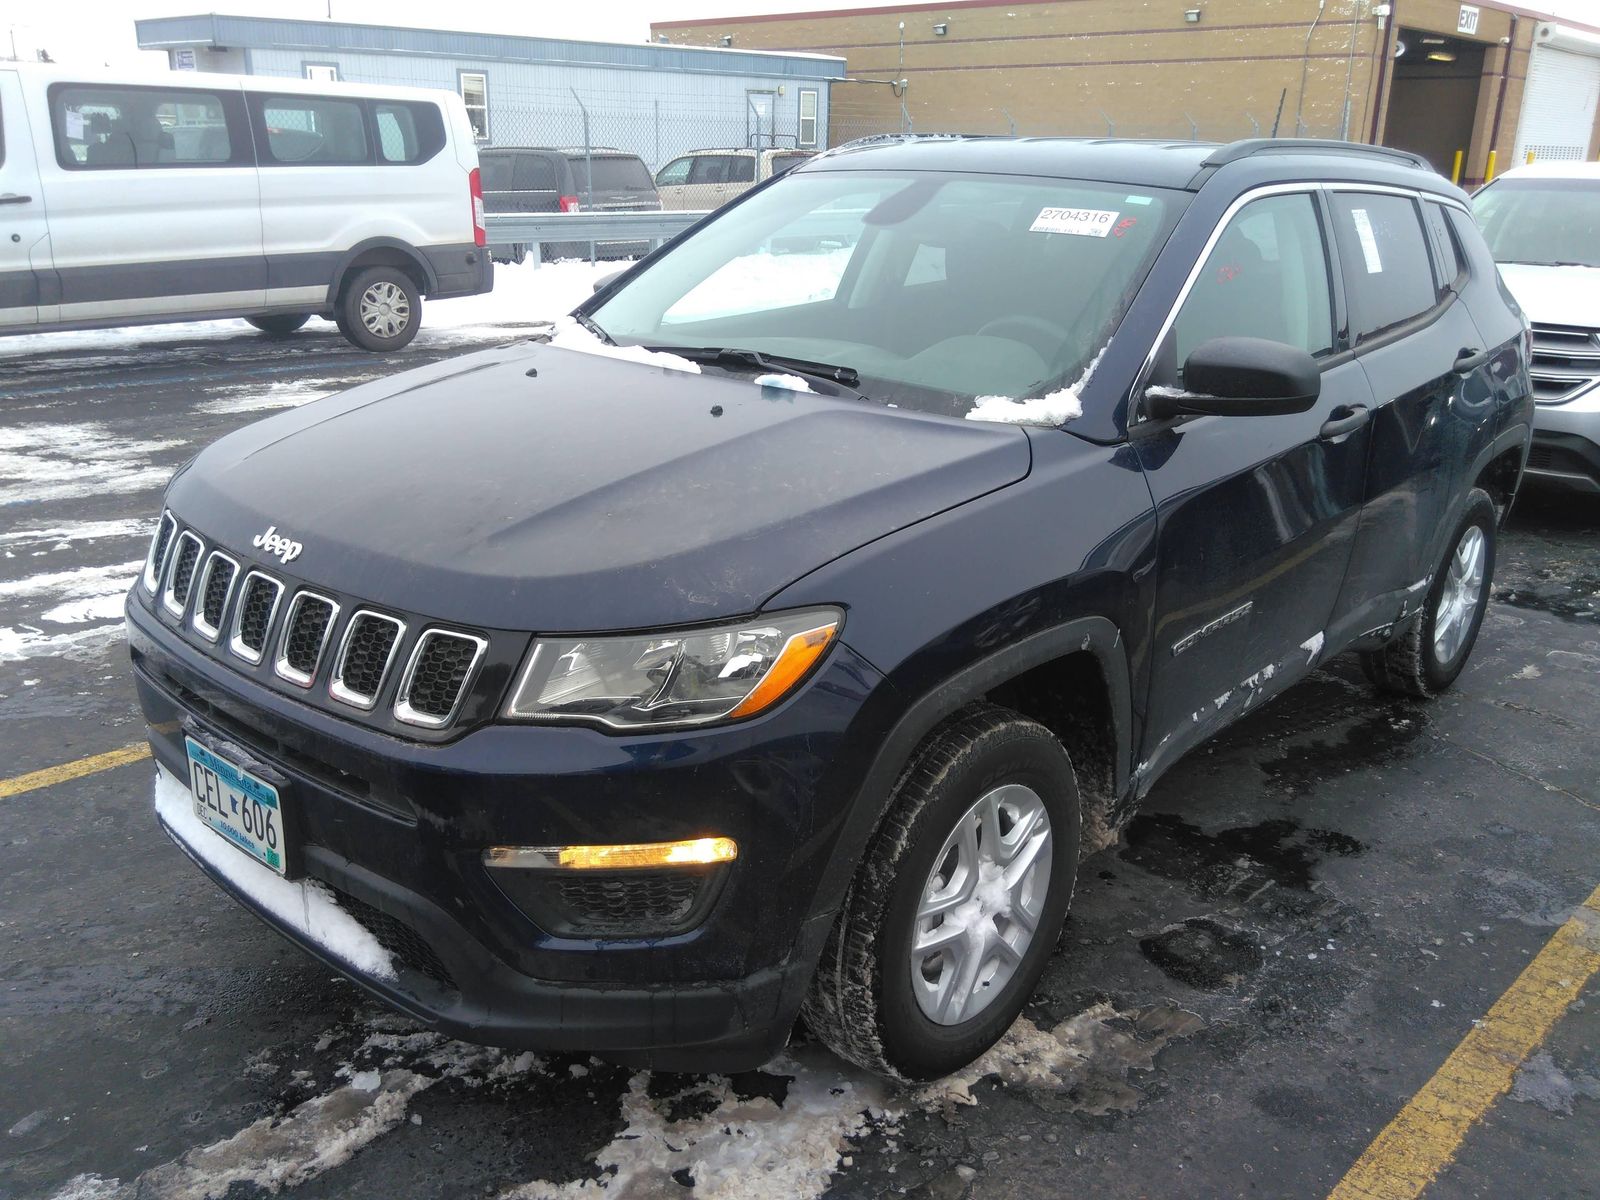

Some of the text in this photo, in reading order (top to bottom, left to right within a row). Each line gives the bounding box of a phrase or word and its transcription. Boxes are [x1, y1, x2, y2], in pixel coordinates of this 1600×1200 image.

[1459, 9, 1478, 30] EXIT
[1040, 209, 1111, 224] 2704316
[253, 525, 303, 565] Jeep
[193, 761, 277, 849] CEL 606
